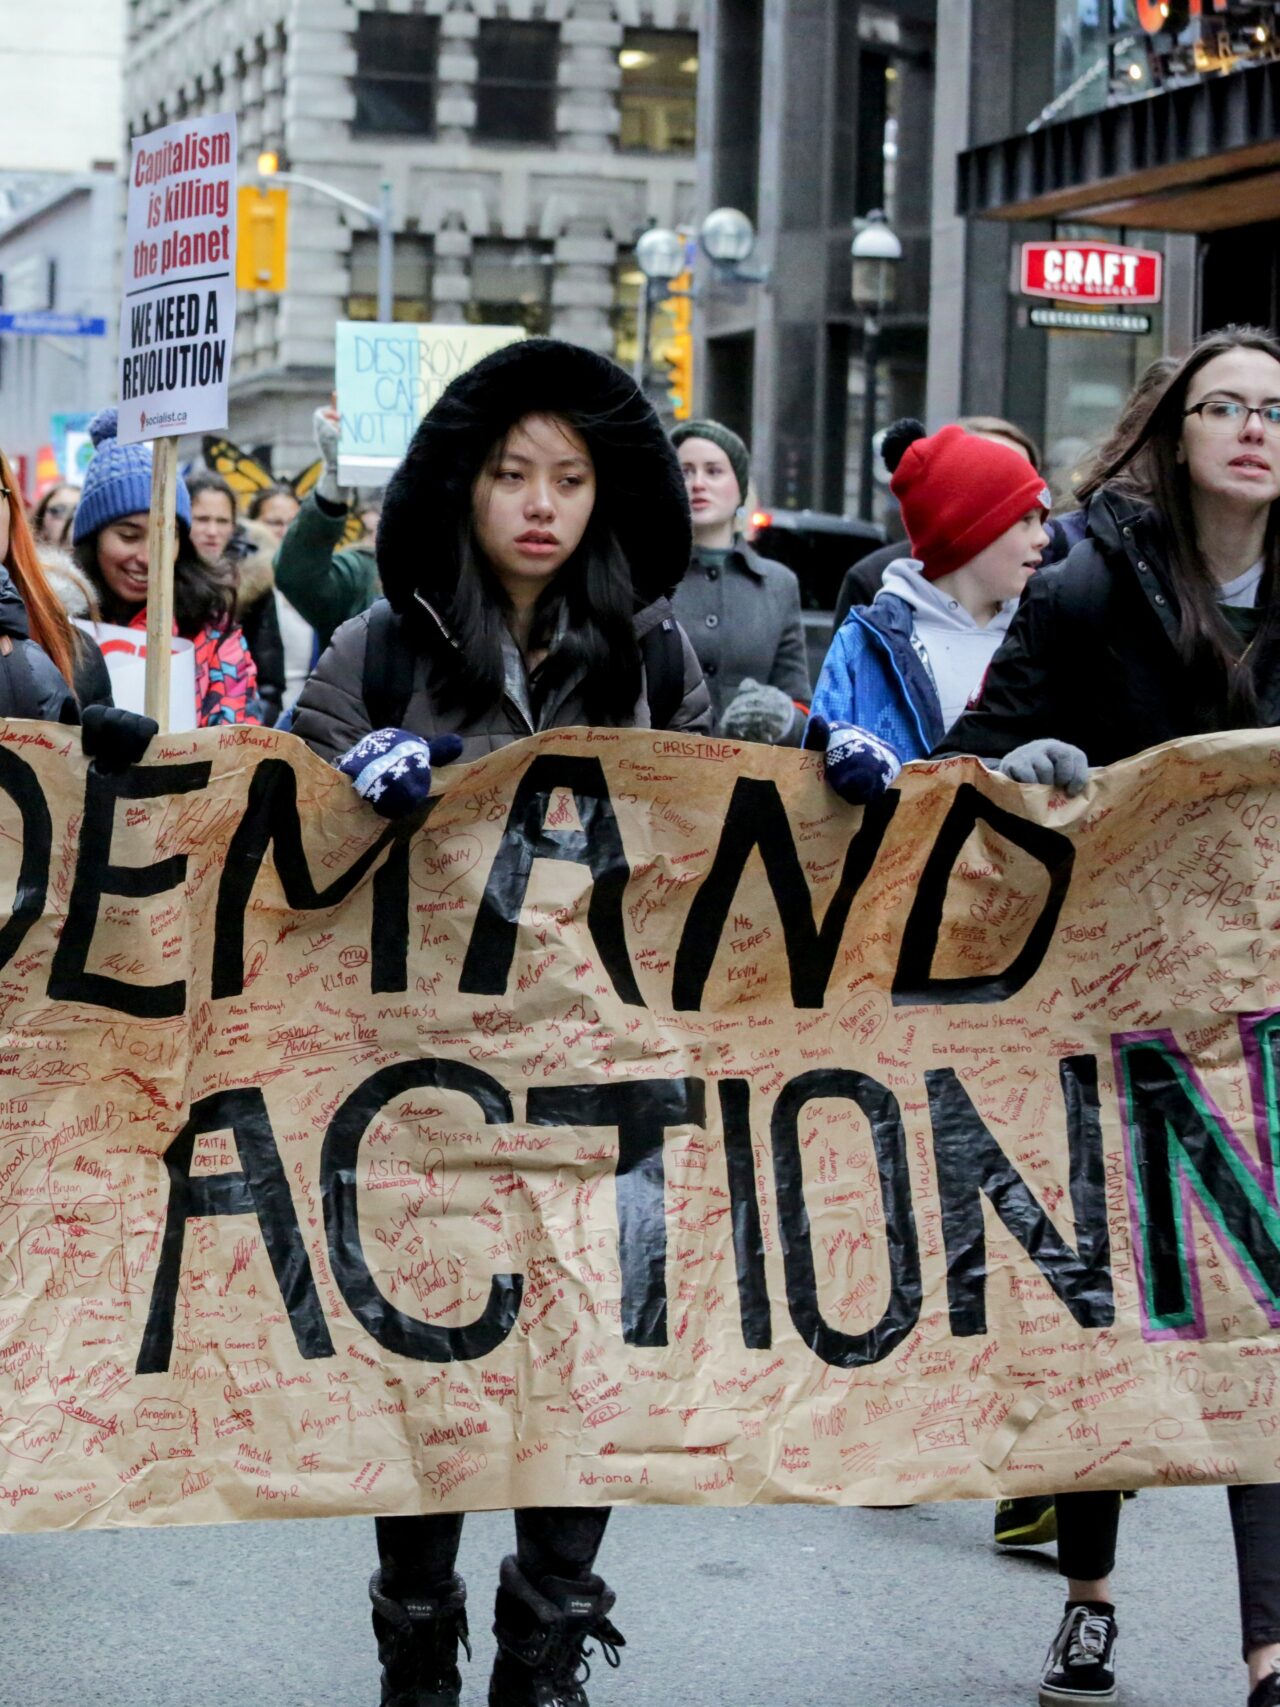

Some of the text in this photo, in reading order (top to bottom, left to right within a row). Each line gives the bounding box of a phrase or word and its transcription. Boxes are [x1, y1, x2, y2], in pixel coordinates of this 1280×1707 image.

[134, 130, 230, 188] Capitalism
[147, 179, 230, 229] is killing
[133, 224, 230, 279] the planet
[1043, 249, 1140, 289] CRAFT
[131, 290, 218, 349] WE NEED A
[123, 339, 226, 401] REVOLUTION
[354, 336, 468, 377] DESTROY
[145, 410, 188, 428] socialist.ca
[340, 412, 386, 444] NOT
[652, 741, 733, 759] CHRISTINE
[194, 1155, 234, 1168] CASTRO
[198, 1136, 227, 1149] FAITH
[136, 1054, 1115, 1374] ACTION
[578, 1472, 632, 1485] Adriana
